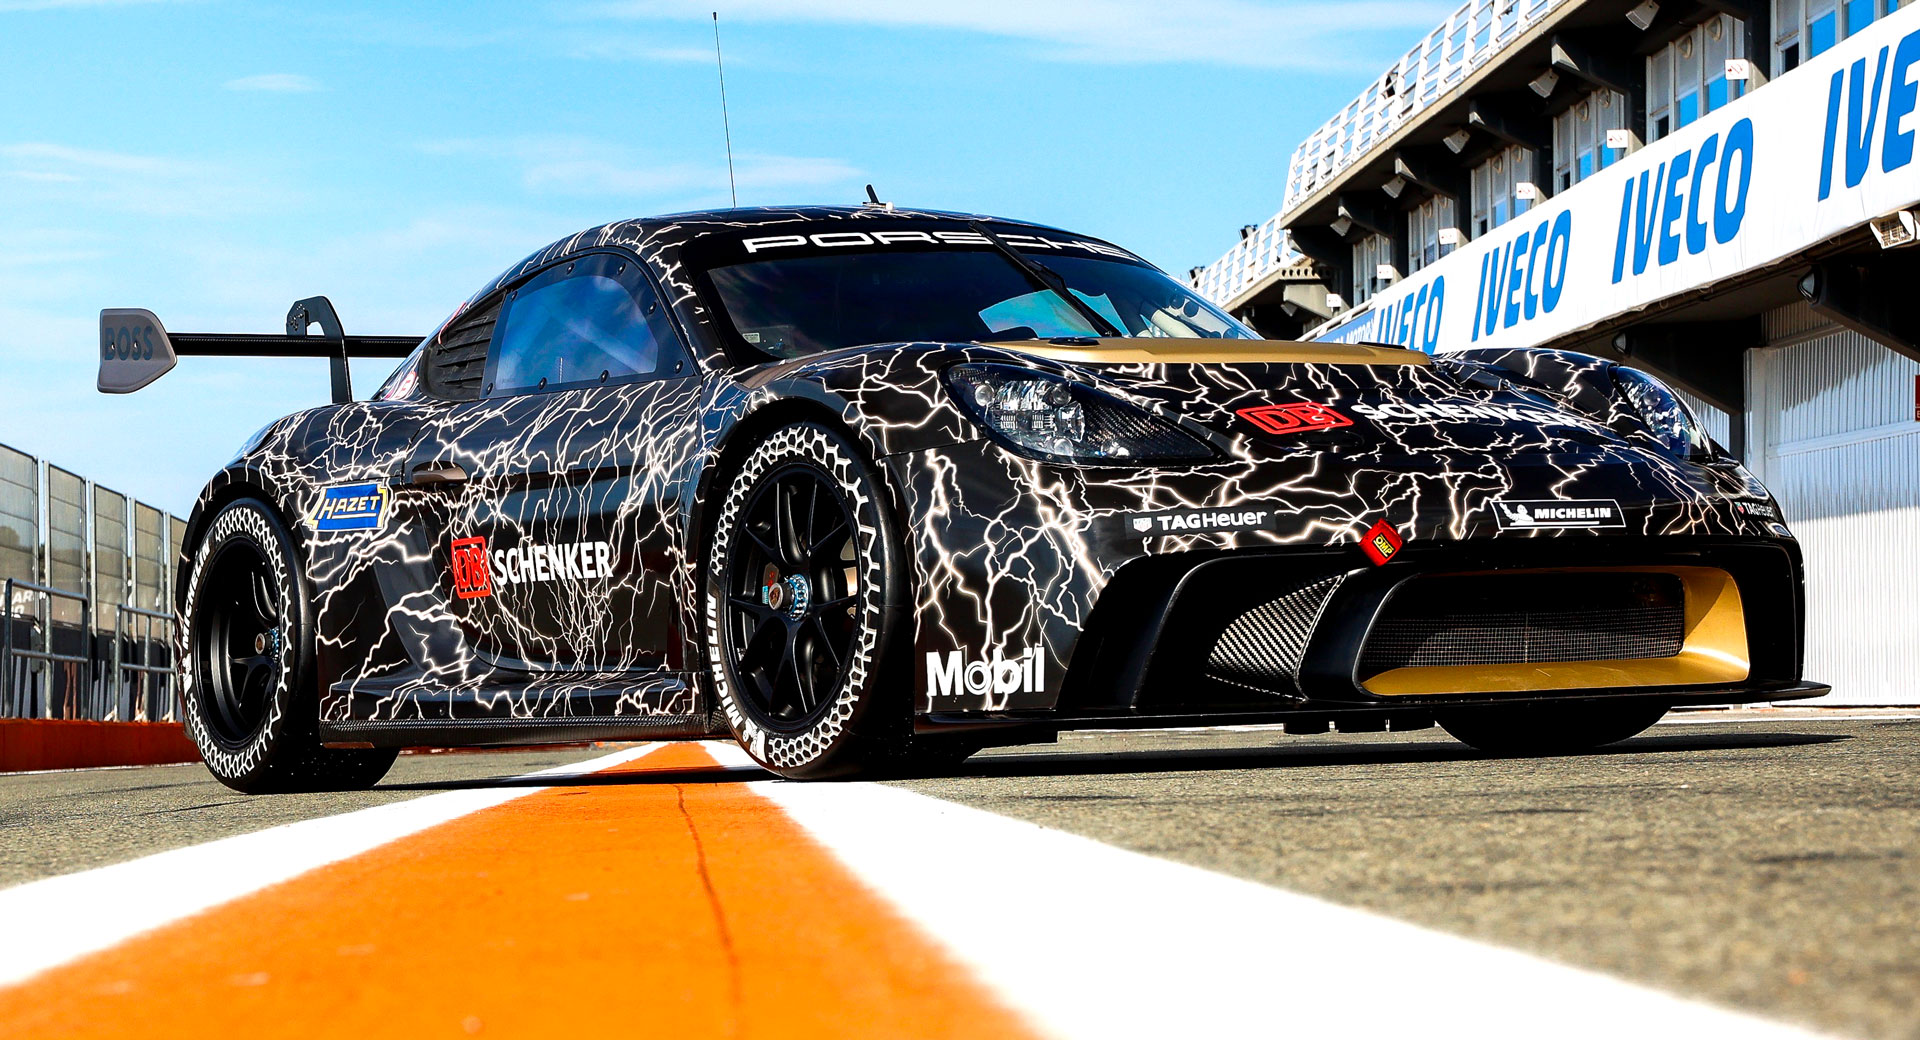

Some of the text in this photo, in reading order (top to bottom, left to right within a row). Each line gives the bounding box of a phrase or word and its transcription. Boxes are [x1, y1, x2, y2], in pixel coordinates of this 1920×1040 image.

[1612, 117, 1754, 285] IVECO
[742, 231, 1139, 262] PORSCHE
[1471, 209, 1571, 342] IVECO
[1376, 275, 1444, 355] IVECO
[104, 326, 153, 361] BOSS
[1252, 403, 1600, 436] DB SCHENKER
[320, 494, 381, 520] HAZET
[1534, 507, 1611, 519] MICHELIN
[456, 541, 614, 589] DB SCHENKER
[1375, 536, 1393, 554] OMP
[182, 539, 211, 649] MICHELIN
[703, 593, 744, 729] MICHELIN
[926, 646, 1045, 697] Mobil
